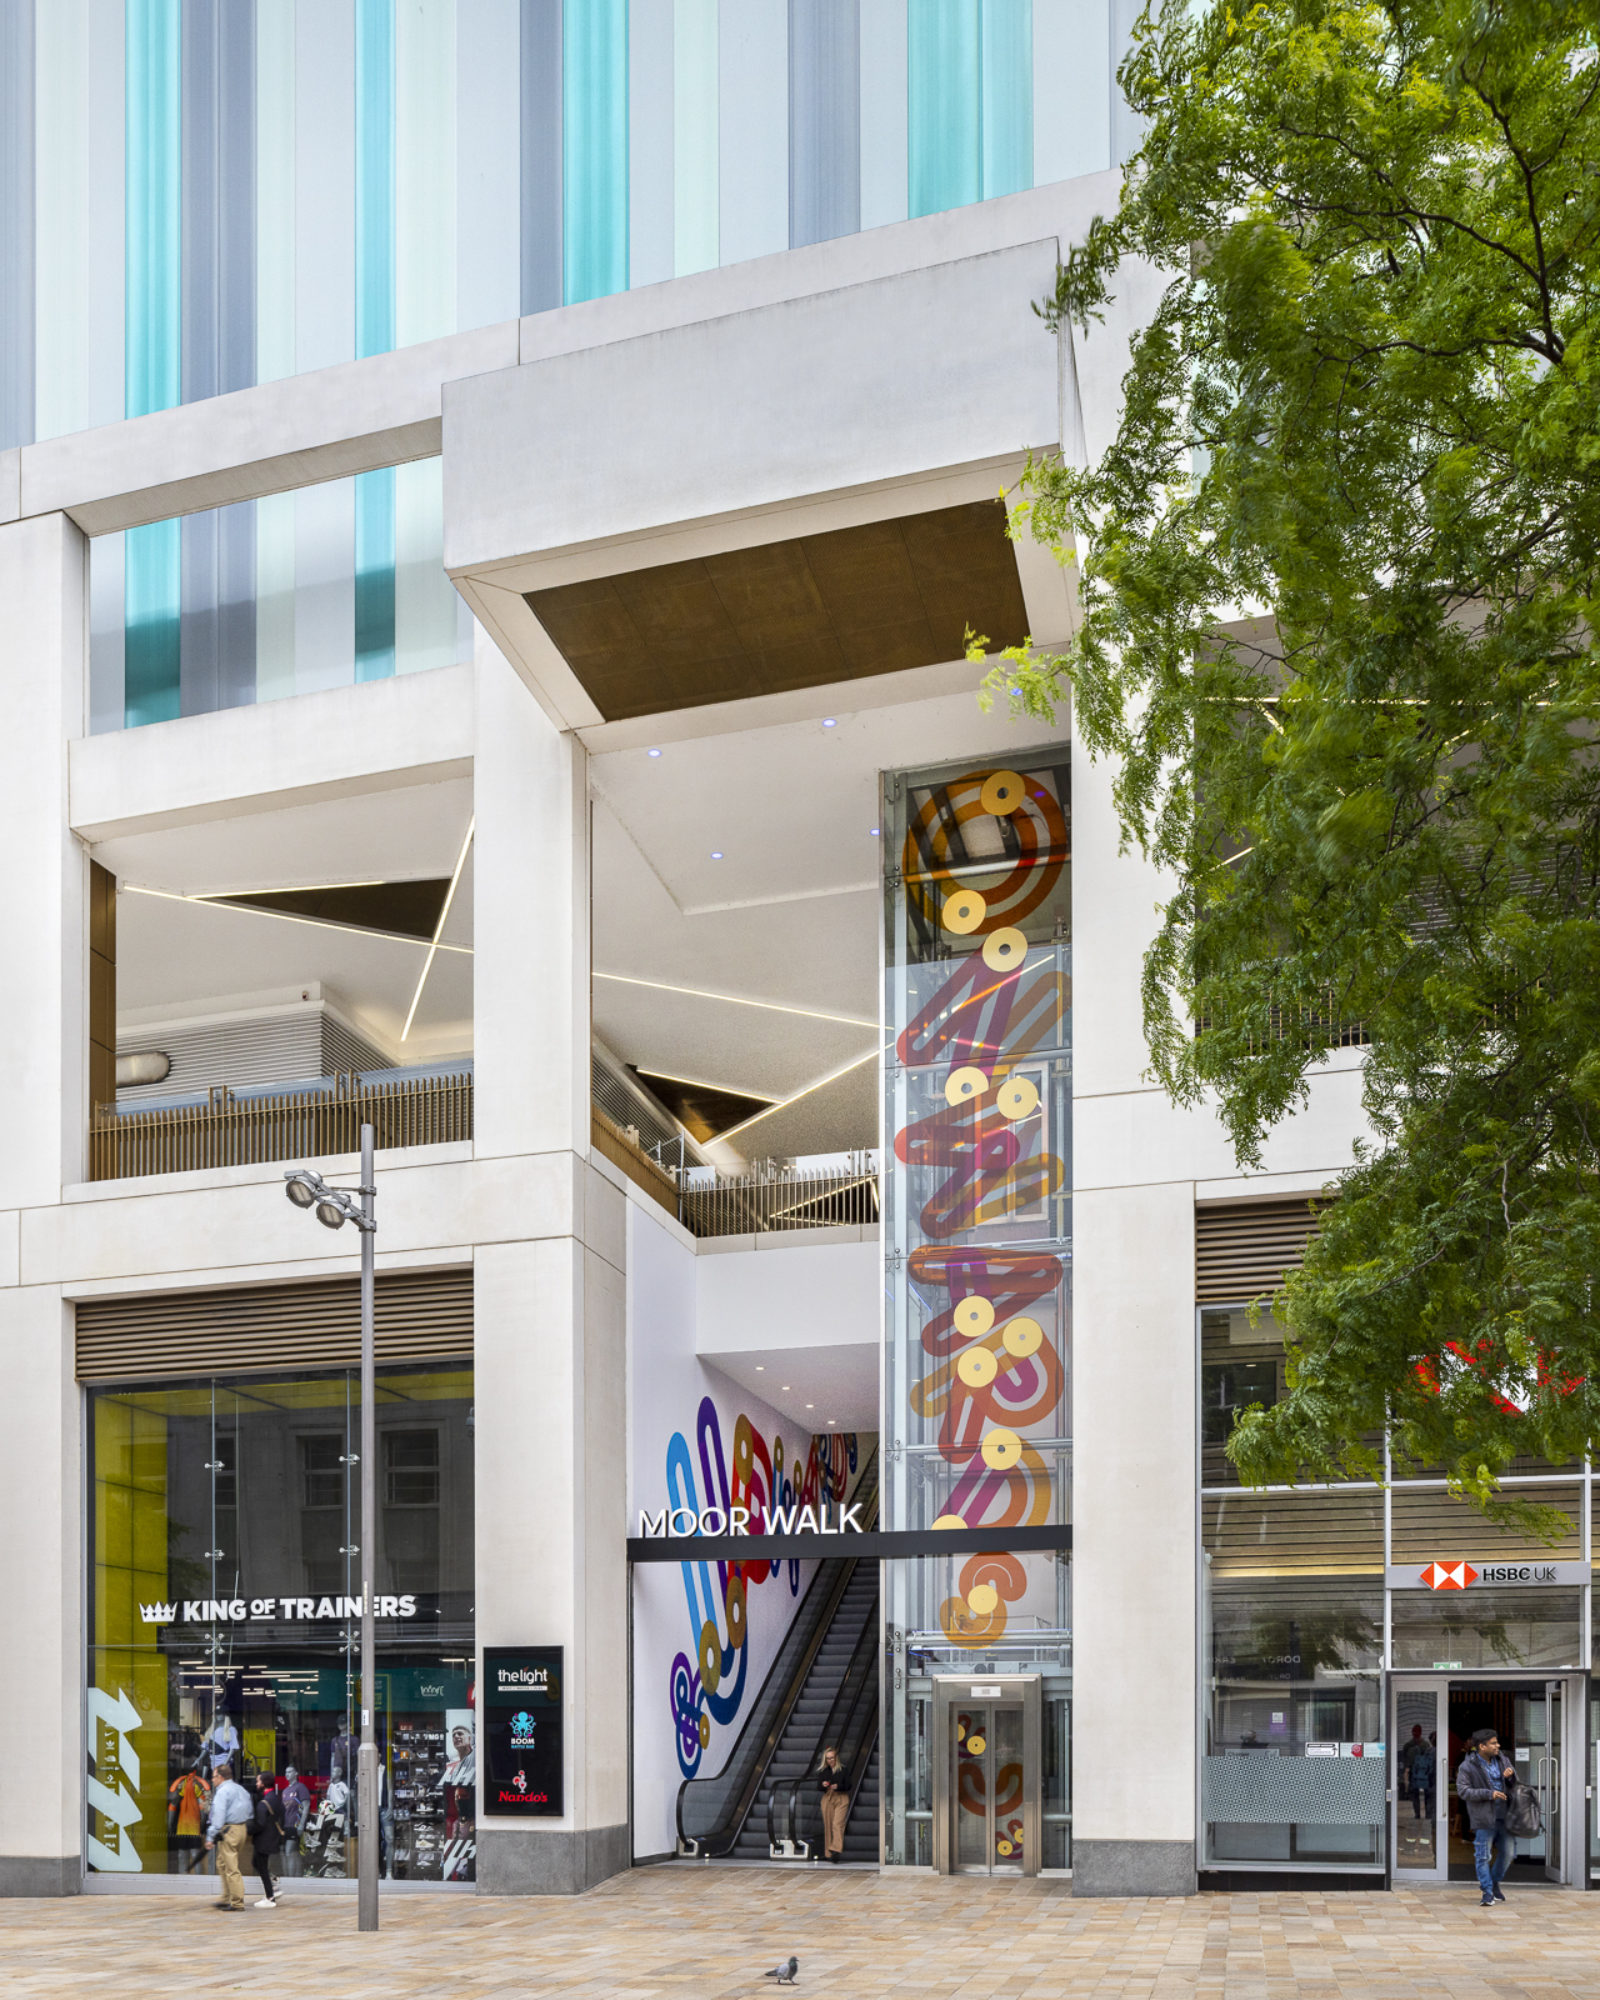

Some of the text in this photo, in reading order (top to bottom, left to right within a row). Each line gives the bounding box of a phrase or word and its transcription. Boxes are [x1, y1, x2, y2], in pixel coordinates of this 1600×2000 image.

[638, 1503, 864, 1538] MOOR WALK
[1483, 1566, 1557, 1582] HSBC UK
[183, 1599, 247, 1622] KING
[250, 1599, 276, 1615] OF
[498, 1790, 549, 1803] Nando's
